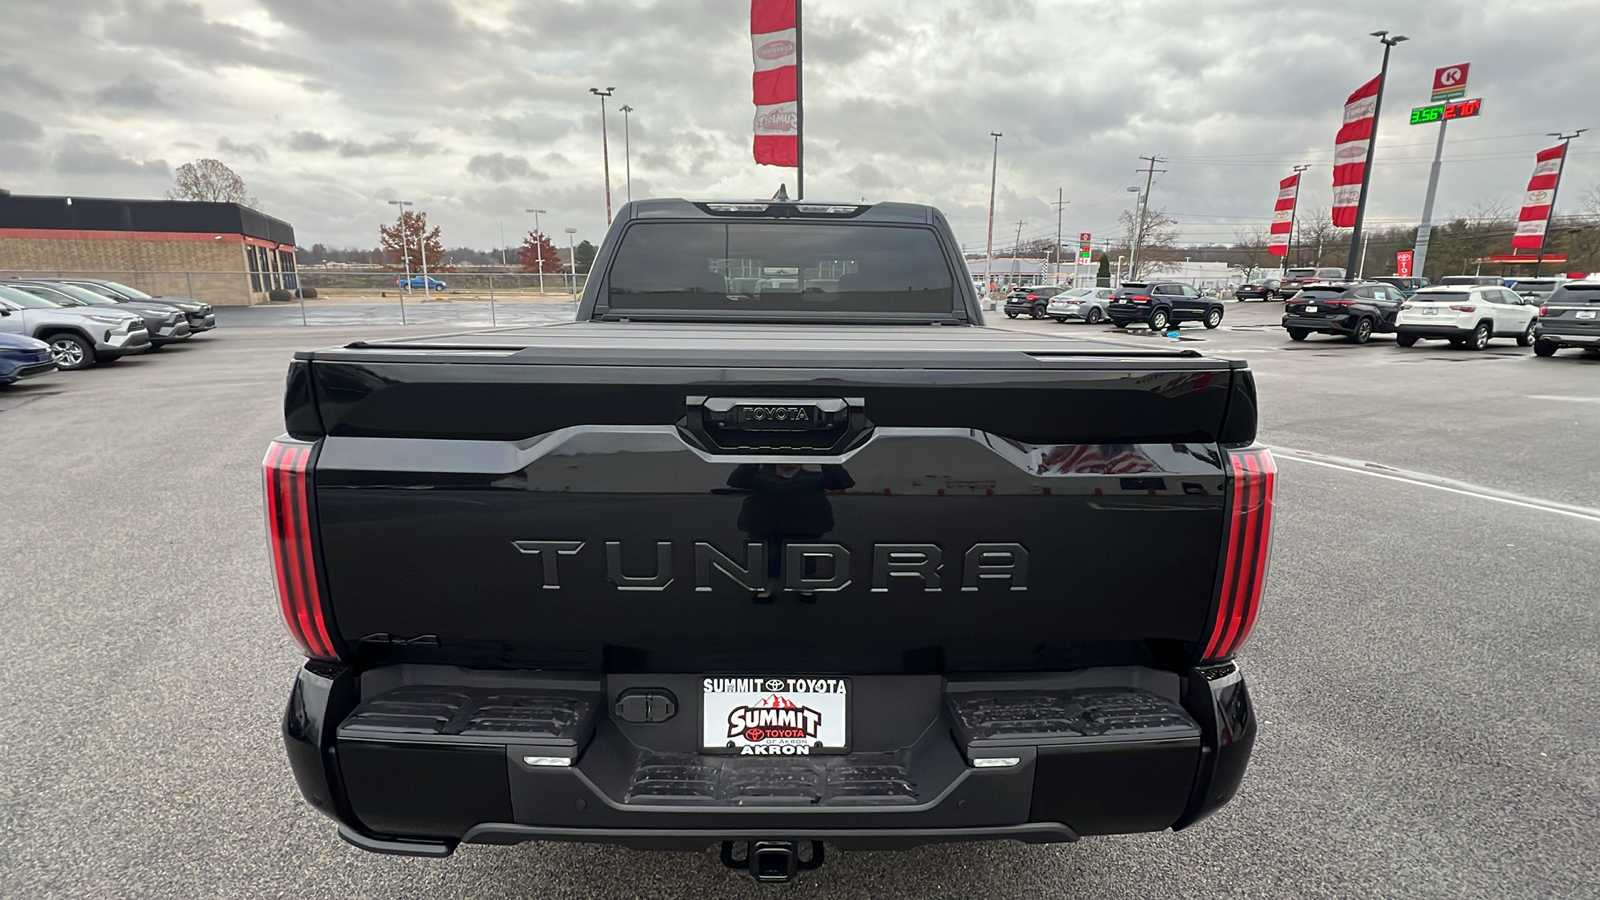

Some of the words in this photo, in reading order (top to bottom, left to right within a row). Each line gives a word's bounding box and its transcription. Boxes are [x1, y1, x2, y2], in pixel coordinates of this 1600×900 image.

[1446, 70, 1458, 82] K
[743, 407, 809, 421] TOYOTA
[510, 540, 1029, 593] TUNDRA
[703, 678, 764, 693] SUMMIT
[787, 678, 847, 694] TOYOTA
[729, 707, 820, 736] SUMMIT
[765, 729, 804, 738] TOYOTA
[740, 745, 810, 755] AKRON
